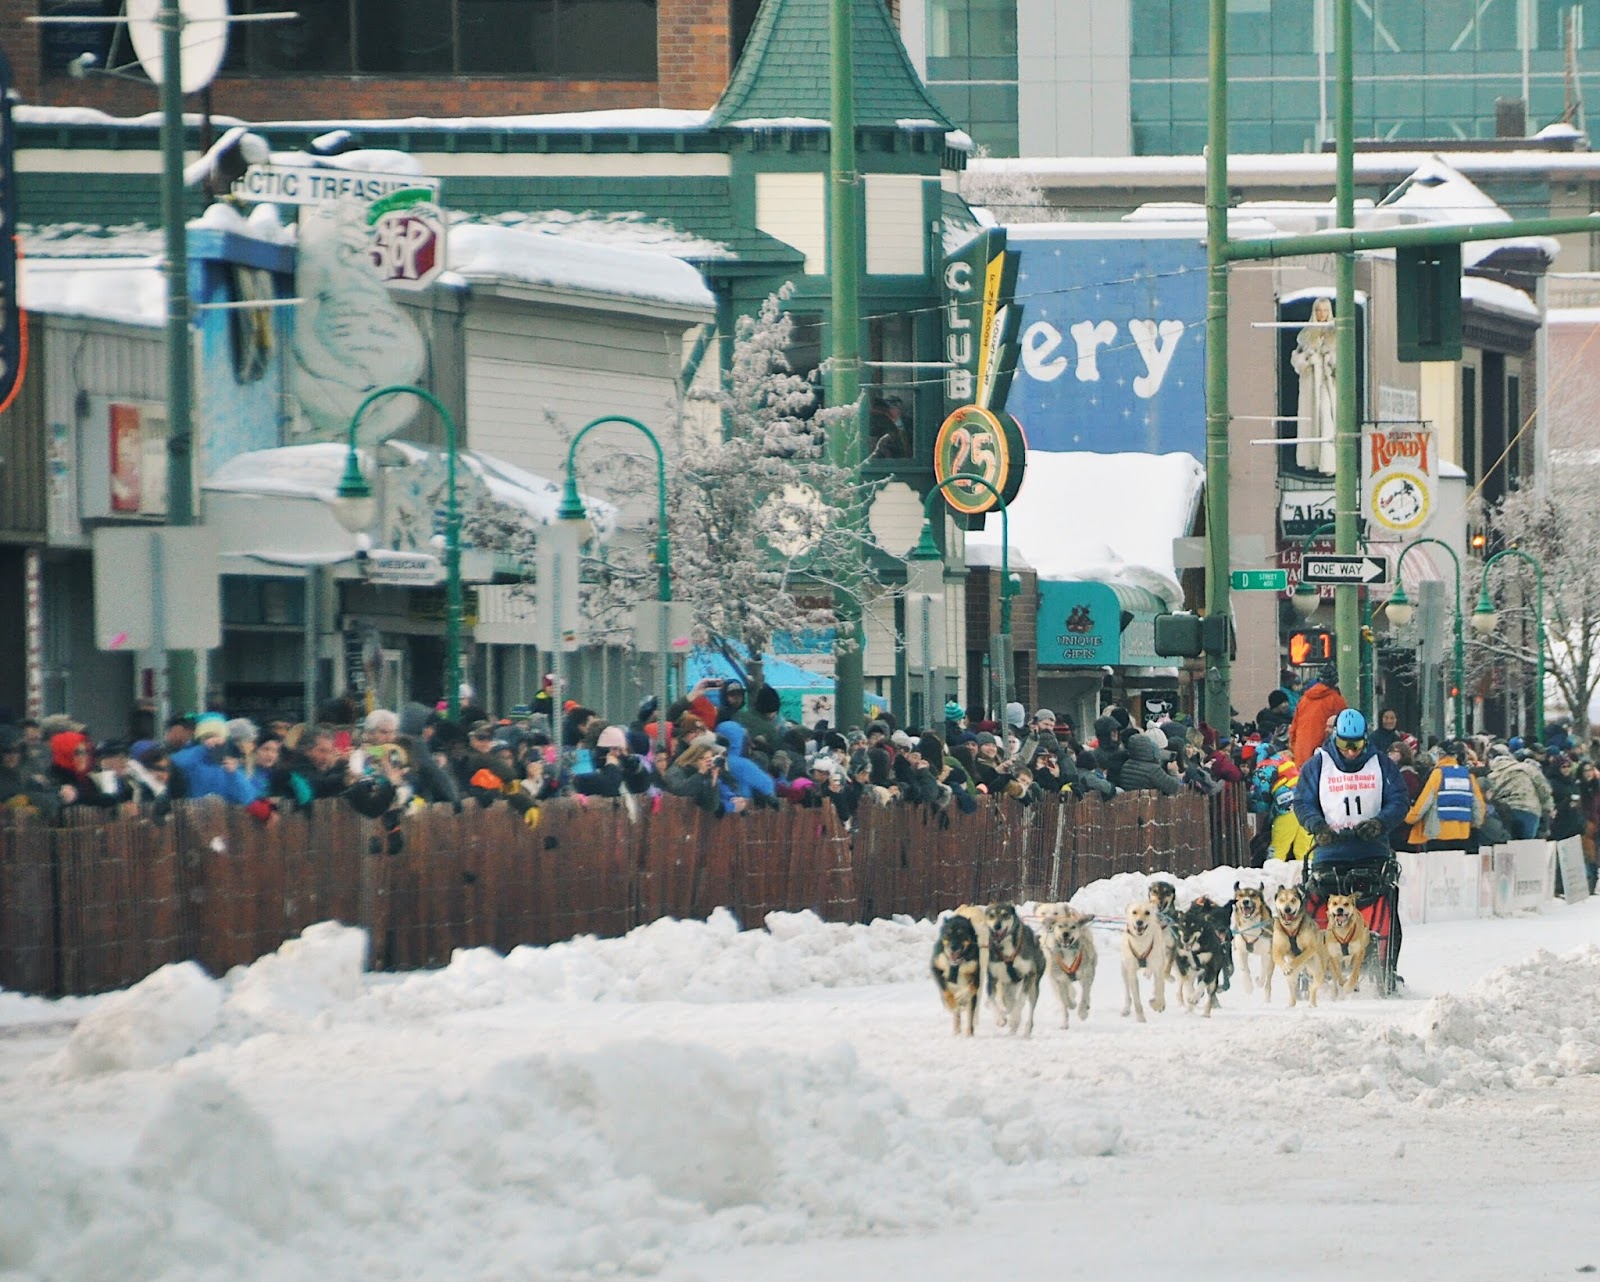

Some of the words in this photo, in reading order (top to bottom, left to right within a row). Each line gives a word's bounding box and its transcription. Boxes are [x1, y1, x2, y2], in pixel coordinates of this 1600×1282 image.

[234, 171, 298, 197] CTIC
[309, 175, 435, 201] TREAS
[945, 261, 973, 399] CLUB
[1021, 319, 1184, 398] ery
[949, 427, 996, 494] 25
[1370, 431, 1431, 478] RONDY
[1293, 504, 1336, 520] Alas
[1313, 563, 1335, 575] ONE
[1340, 564, 1363, 575] WAY
[1242, 573, 1249, 587] D
[1286, 584, 1336, 598] OET
[1056, 635, 1102, 646] UNIQUE
[1063, 649, 1095, 659] GIFTS
[1344, 796, 1361, 816] 11
